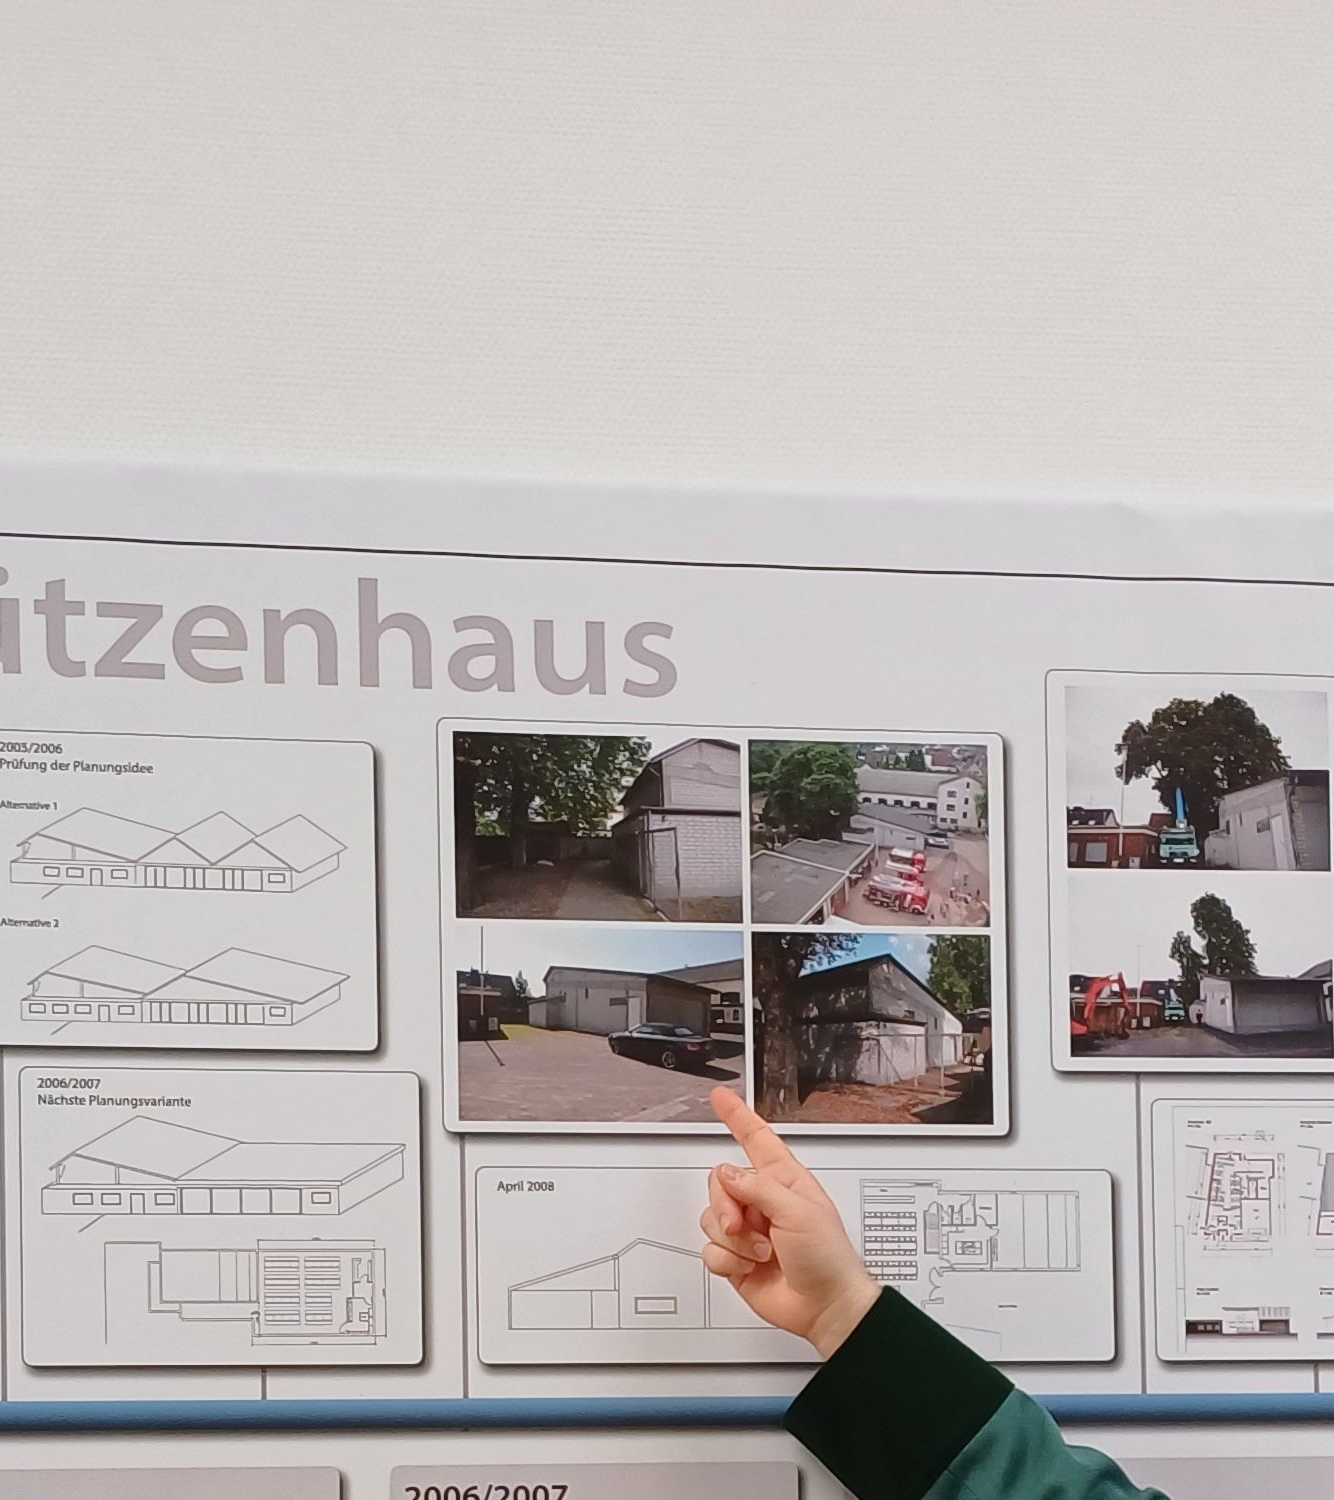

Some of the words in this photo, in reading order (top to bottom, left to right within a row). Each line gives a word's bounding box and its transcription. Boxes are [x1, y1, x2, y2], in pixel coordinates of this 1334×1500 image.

[49, 759, 71, 771] der
[72, 760, 154, 775] Planungsidee
[36, 1077, 102, 1089] 2006/2007
[37, 1093, 87, 1105] Nächste
[88, 1094, 192, 1109] Planungsvariante
[496, 1179, 525, 1194] April
[526, 1180, 555, 1191] 2008
